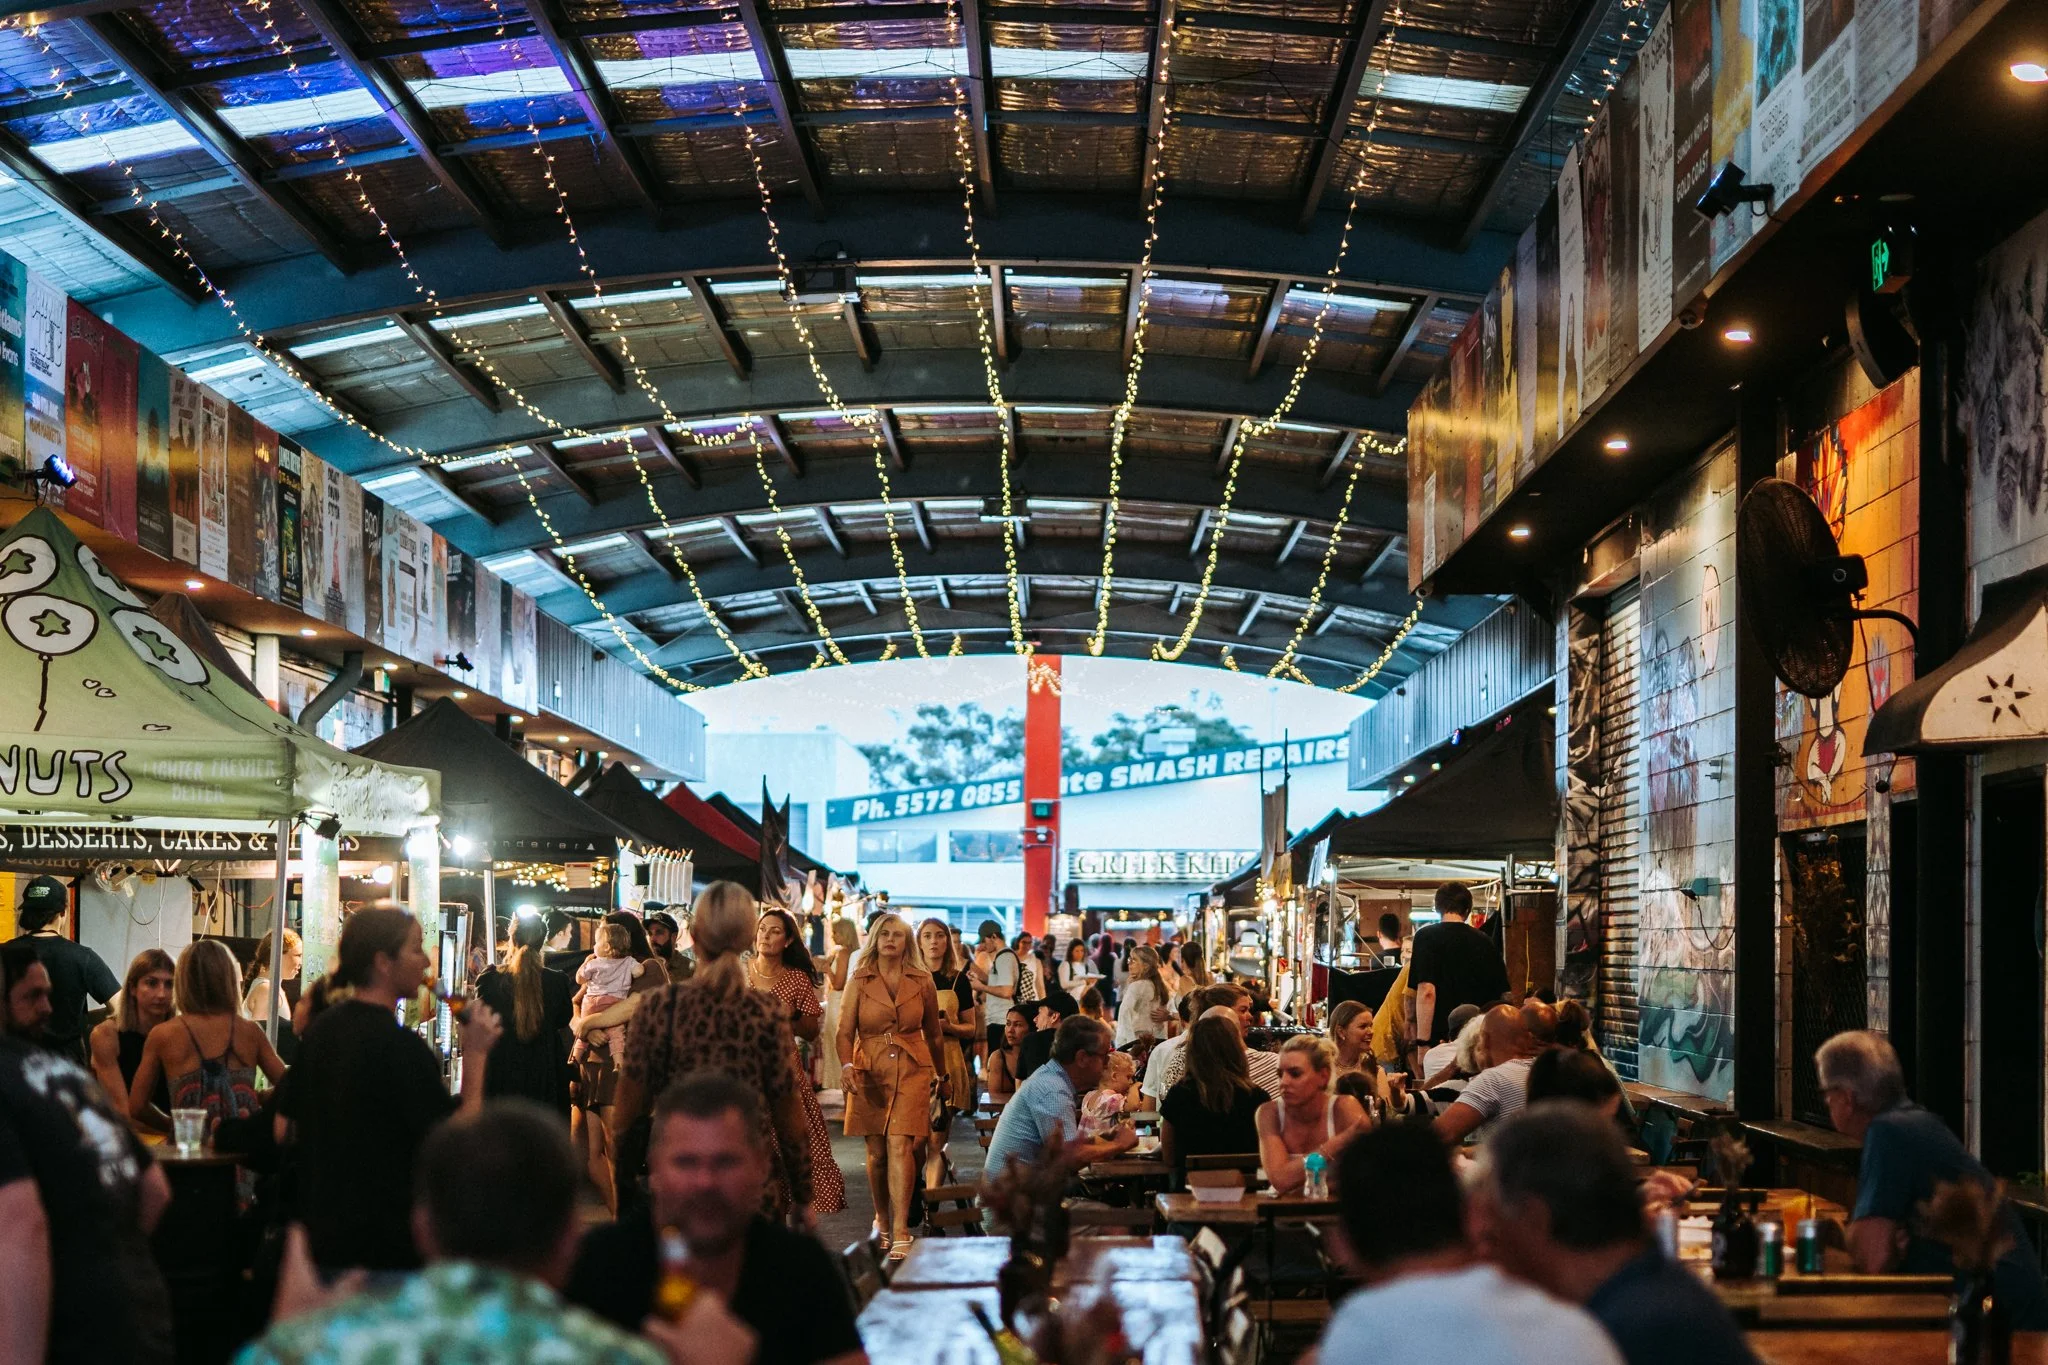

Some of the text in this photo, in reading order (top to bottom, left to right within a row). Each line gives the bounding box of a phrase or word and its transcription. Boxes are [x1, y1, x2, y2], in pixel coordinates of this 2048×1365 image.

[0, 744, 133, 804] NUTS
[211, 758, 276, 778] FRESHER
[1109, 753, 1217, 789] SMASH
[1223, 736, 1349, 774] REPAIRS
[851, 779, 1021, 821] Ph. 5572 0855
[21, 825, 153, 853] DESSERTS,
[160, 829, 242, 851] CAKES
[248, 832, 268, 851] &
[1077, 854, 1178, 875] GREEK
